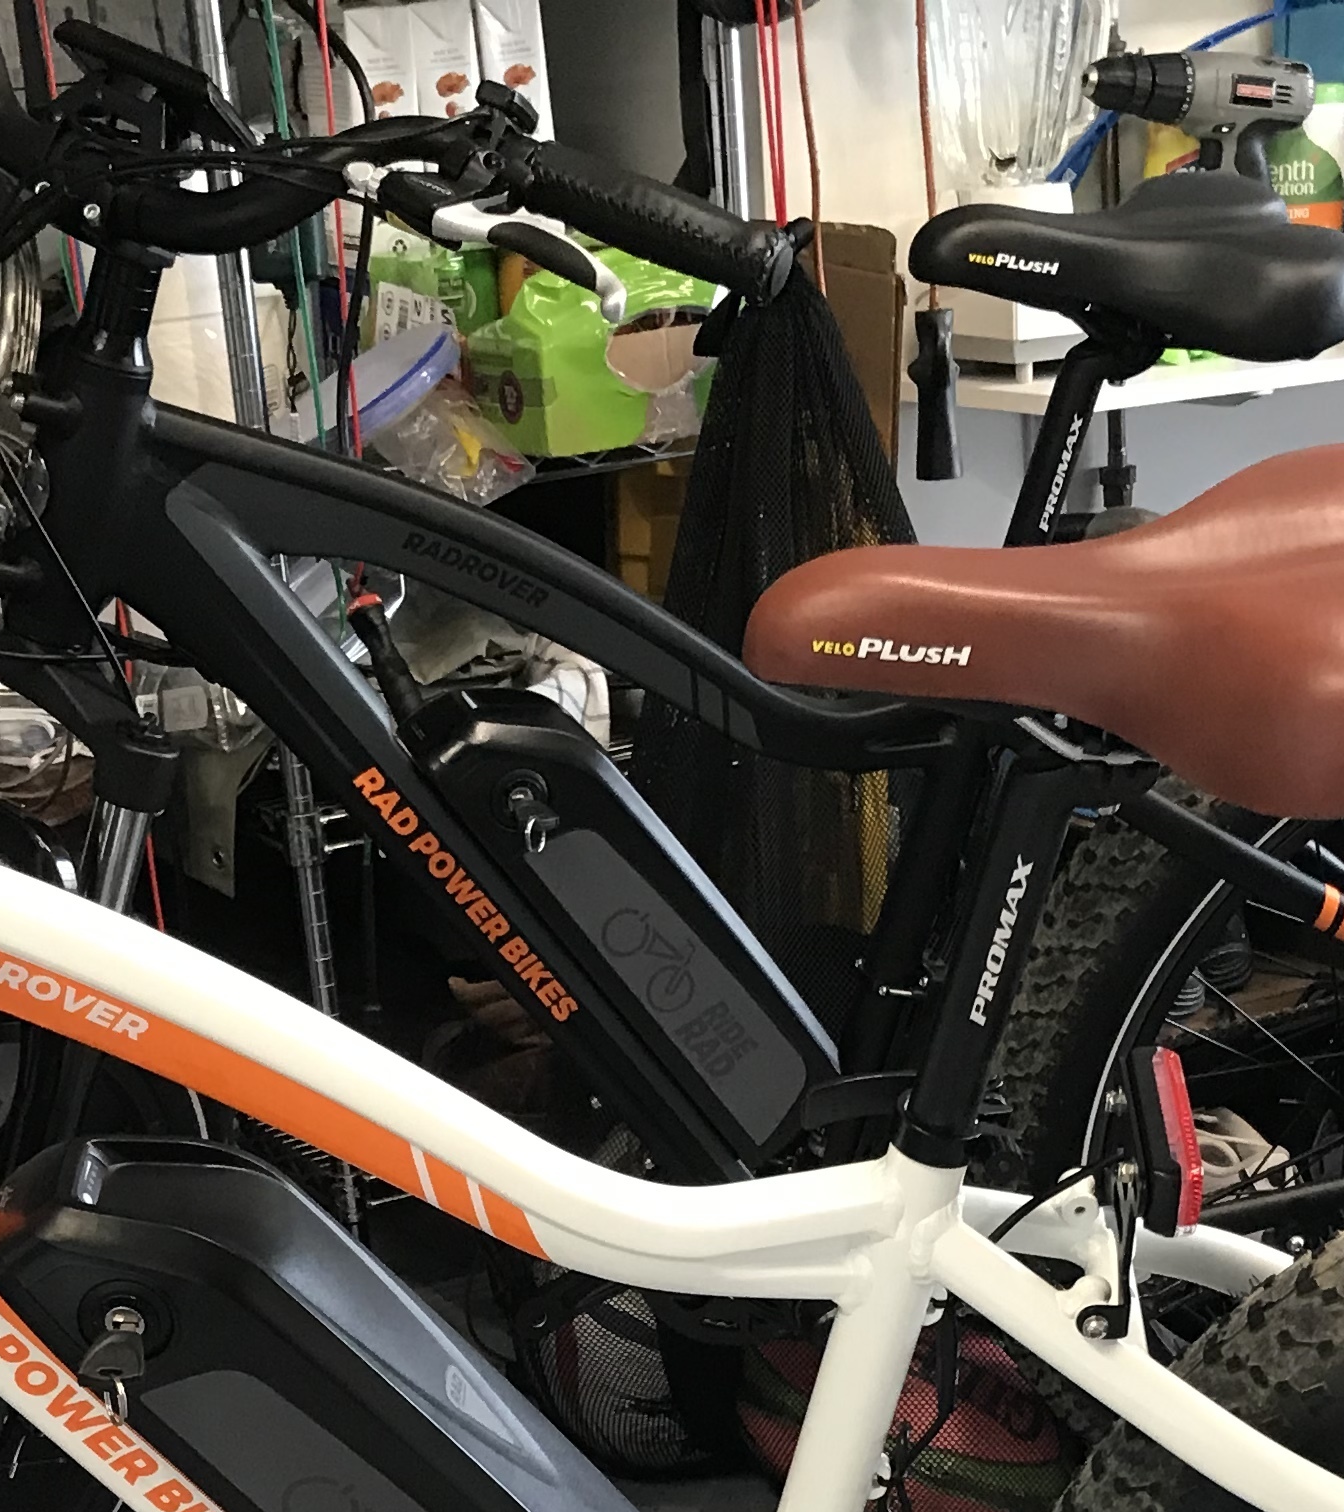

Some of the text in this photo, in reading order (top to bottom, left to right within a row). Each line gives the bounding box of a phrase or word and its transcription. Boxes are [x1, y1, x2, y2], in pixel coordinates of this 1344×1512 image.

[1270, 160, 1314, 181] enth
[968, 252, 1060, 276] VELO PLUSH
[1039, 413, 1083, 533] PROMAX
[402, 532, 549, 608] RADROVER
[812, 636, 972, 667] VELO PLUSH
[353, 766, 579, 1022] RAD POWER BIKES
[969, 853, 1034, 1027] PROMAX
[674, 1018, 736, 1077] RAD
[702, 1001, 759, 1061] RIDE
